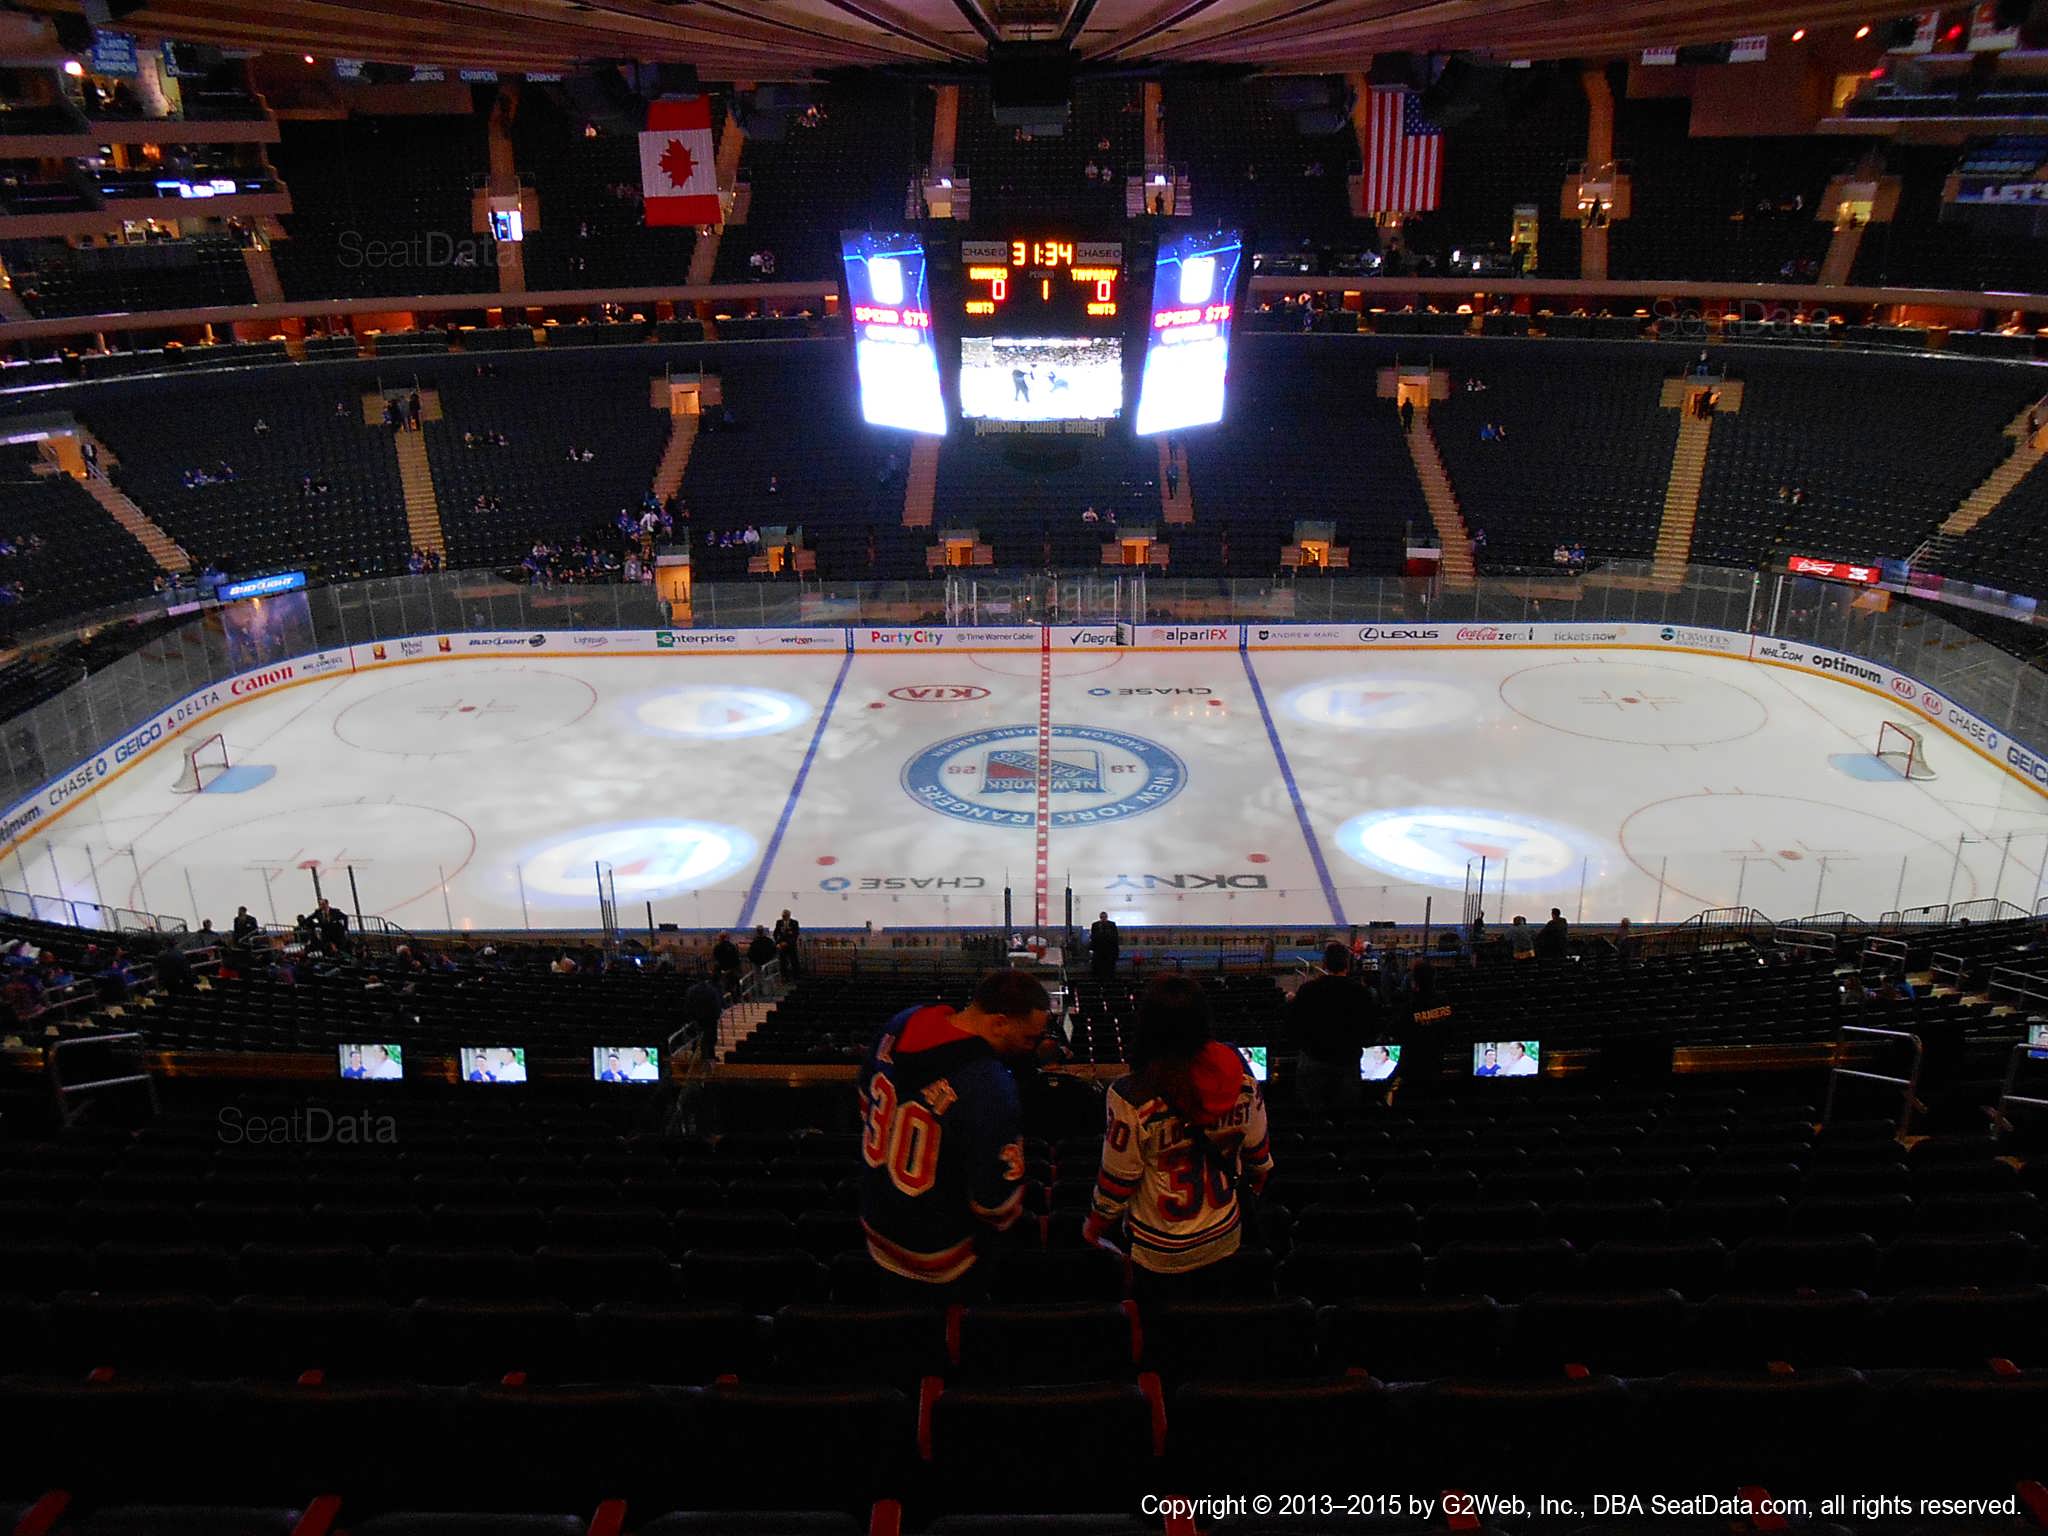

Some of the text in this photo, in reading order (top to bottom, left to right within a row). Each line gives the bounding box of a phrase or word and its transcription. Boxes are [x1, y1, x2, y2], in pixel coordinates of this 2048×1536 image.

[963, 249, 998, 257] CHASE
[1078, 250, 1112, 258] CHASE
[992, 279, 1006, 301] 0
[1097, 280, 1111, 302] 0
[967, 633, 1034, 641] Time Warner Cable
[1082, 632, 1117, 645] Degre
[1314, 631, 1340, 639] MARC
[1381, 630, 1440, 639] LEXUS
[1498, 630, 1528, 641] zero
[1760, 645, 1805, 663] NHL.COM
[1812, 653, 1882, 685] optimum
[230, 665, 294, 696] Canon
[1119, 687, 1213, 697] CHASE
[176, 691, 221, 721] DELTA
[1948, 708, 1987, 743] CHASE
[115, 722, 162, 763] GEICO
[49, 766, 96, 806] CHASE
[986, 778, 1098, 791] NEW YORK
[918, 775, 1175, 824] NEW YORK RANGERS
[858, 876, 986, 890] CHASE
[1106, 873, 1269, 890] DKNY
[1413, 1005, 1453, 1023] RANGERS
[863, 1071, 944, 1199] 30
